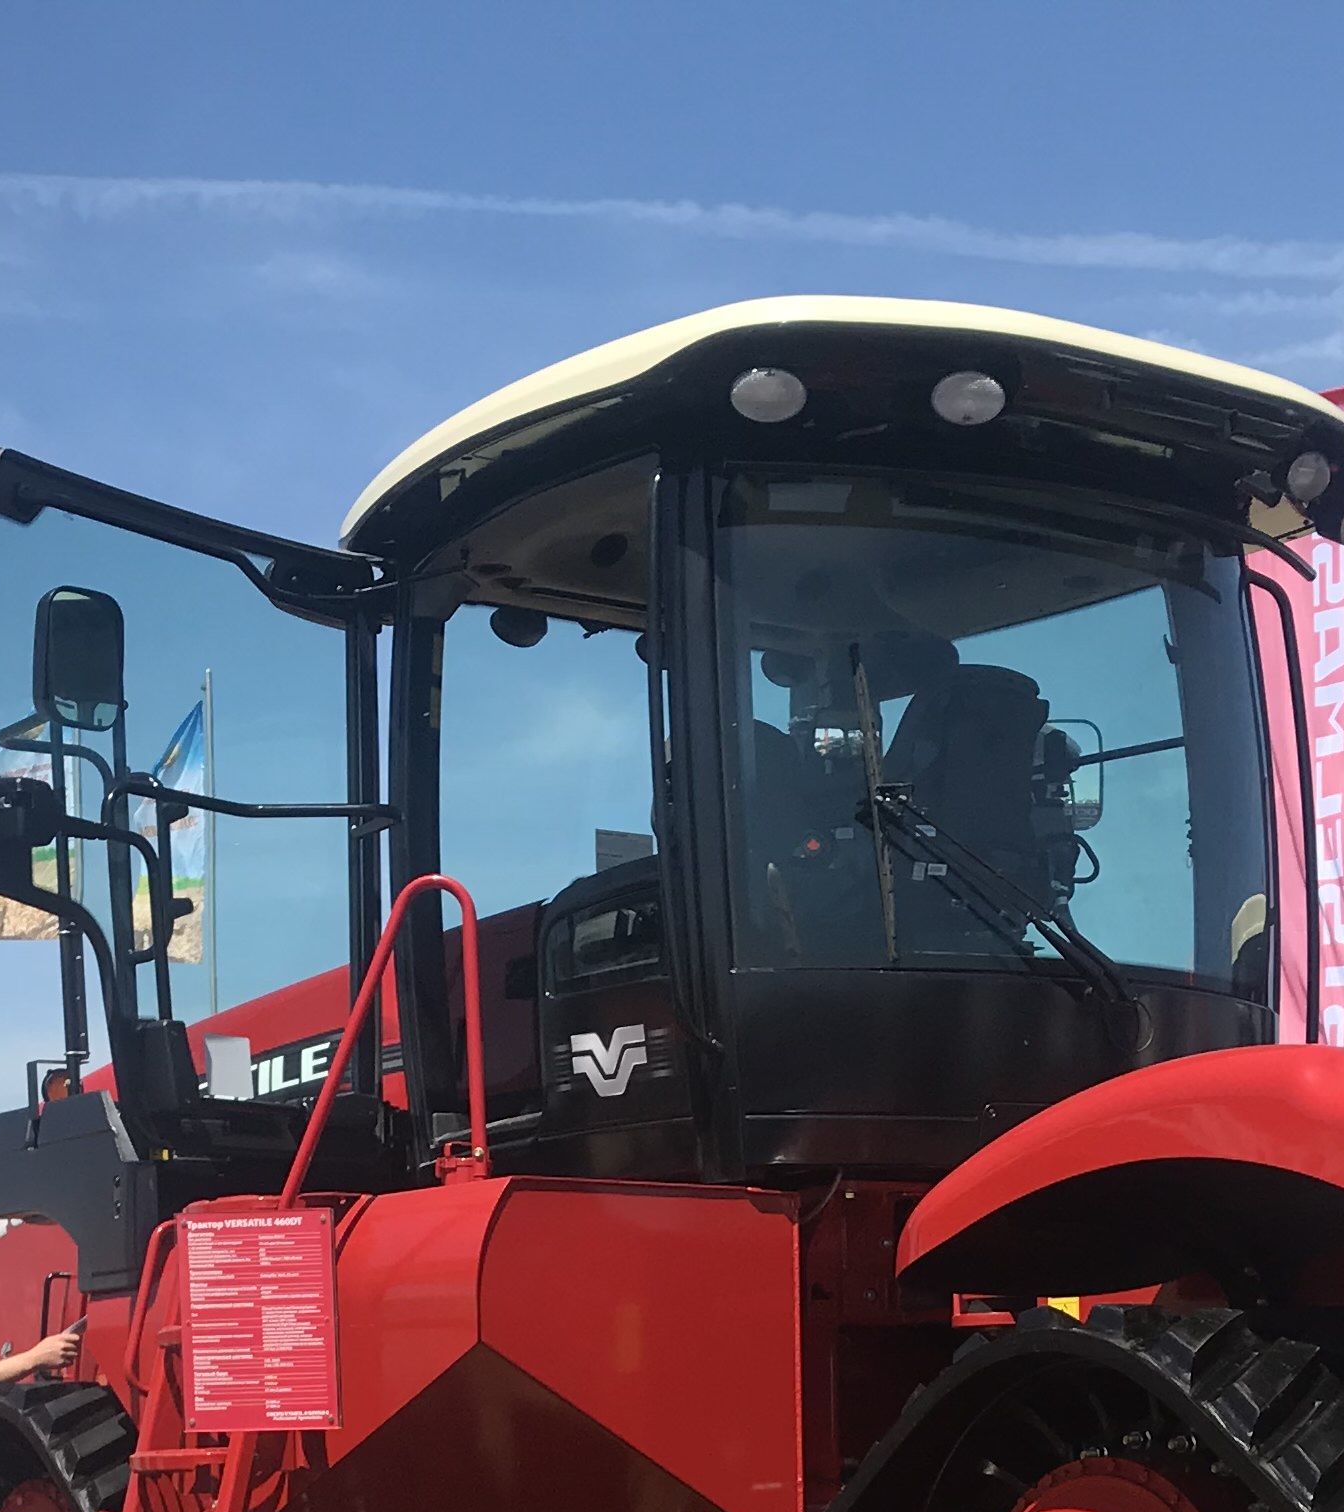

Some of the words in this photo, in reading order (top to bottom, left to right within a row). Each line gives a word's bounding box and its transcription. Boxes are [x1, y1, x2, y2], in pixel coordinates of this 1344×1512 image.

[248, 1041, 332, 1096] ILE
[187, 1220, 224, 1231] Трактор
[224, 1217, 273, 1228] VERSATILE
[273, 1216, 303, 1226] 460DT
